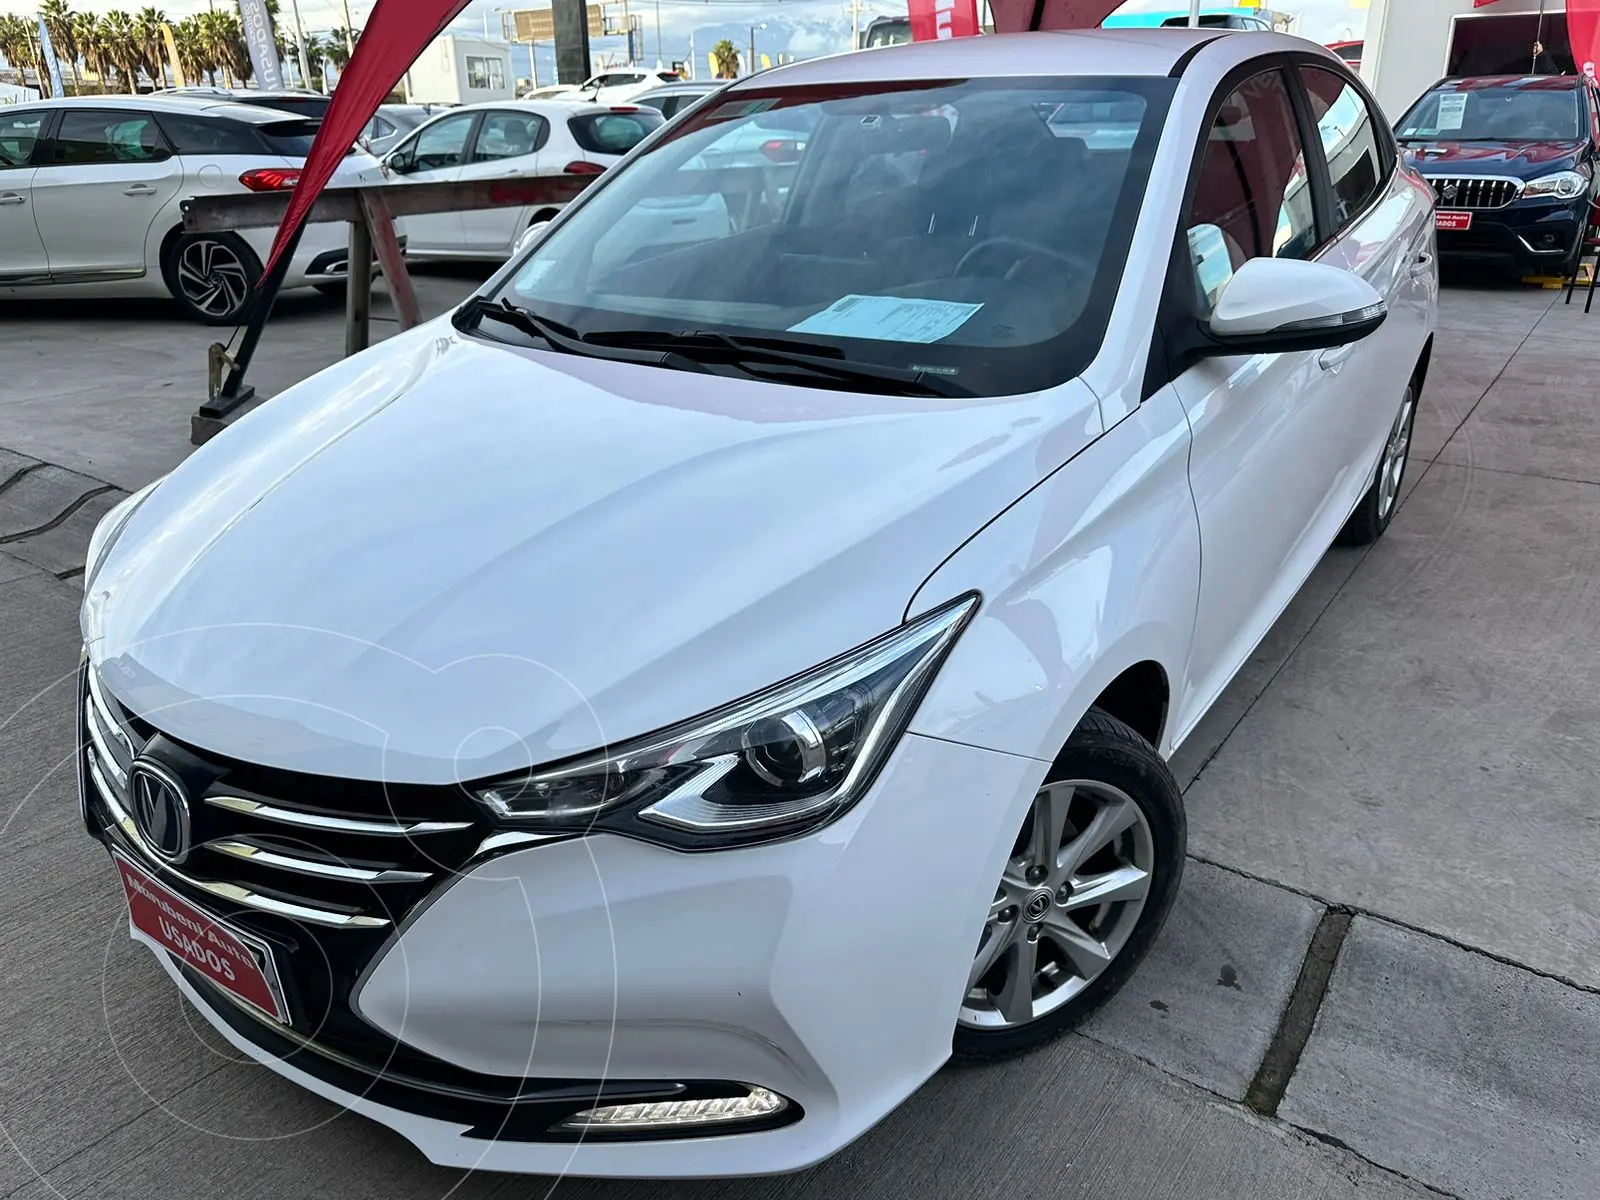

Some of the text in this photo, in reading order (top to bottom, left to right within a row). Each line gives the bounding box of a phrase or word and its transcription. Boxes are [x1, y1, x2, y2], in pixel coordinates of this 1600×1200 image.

[126, 873, 254, 970] Marubeni Auto
[158, 916, 236, 981] USADOS
